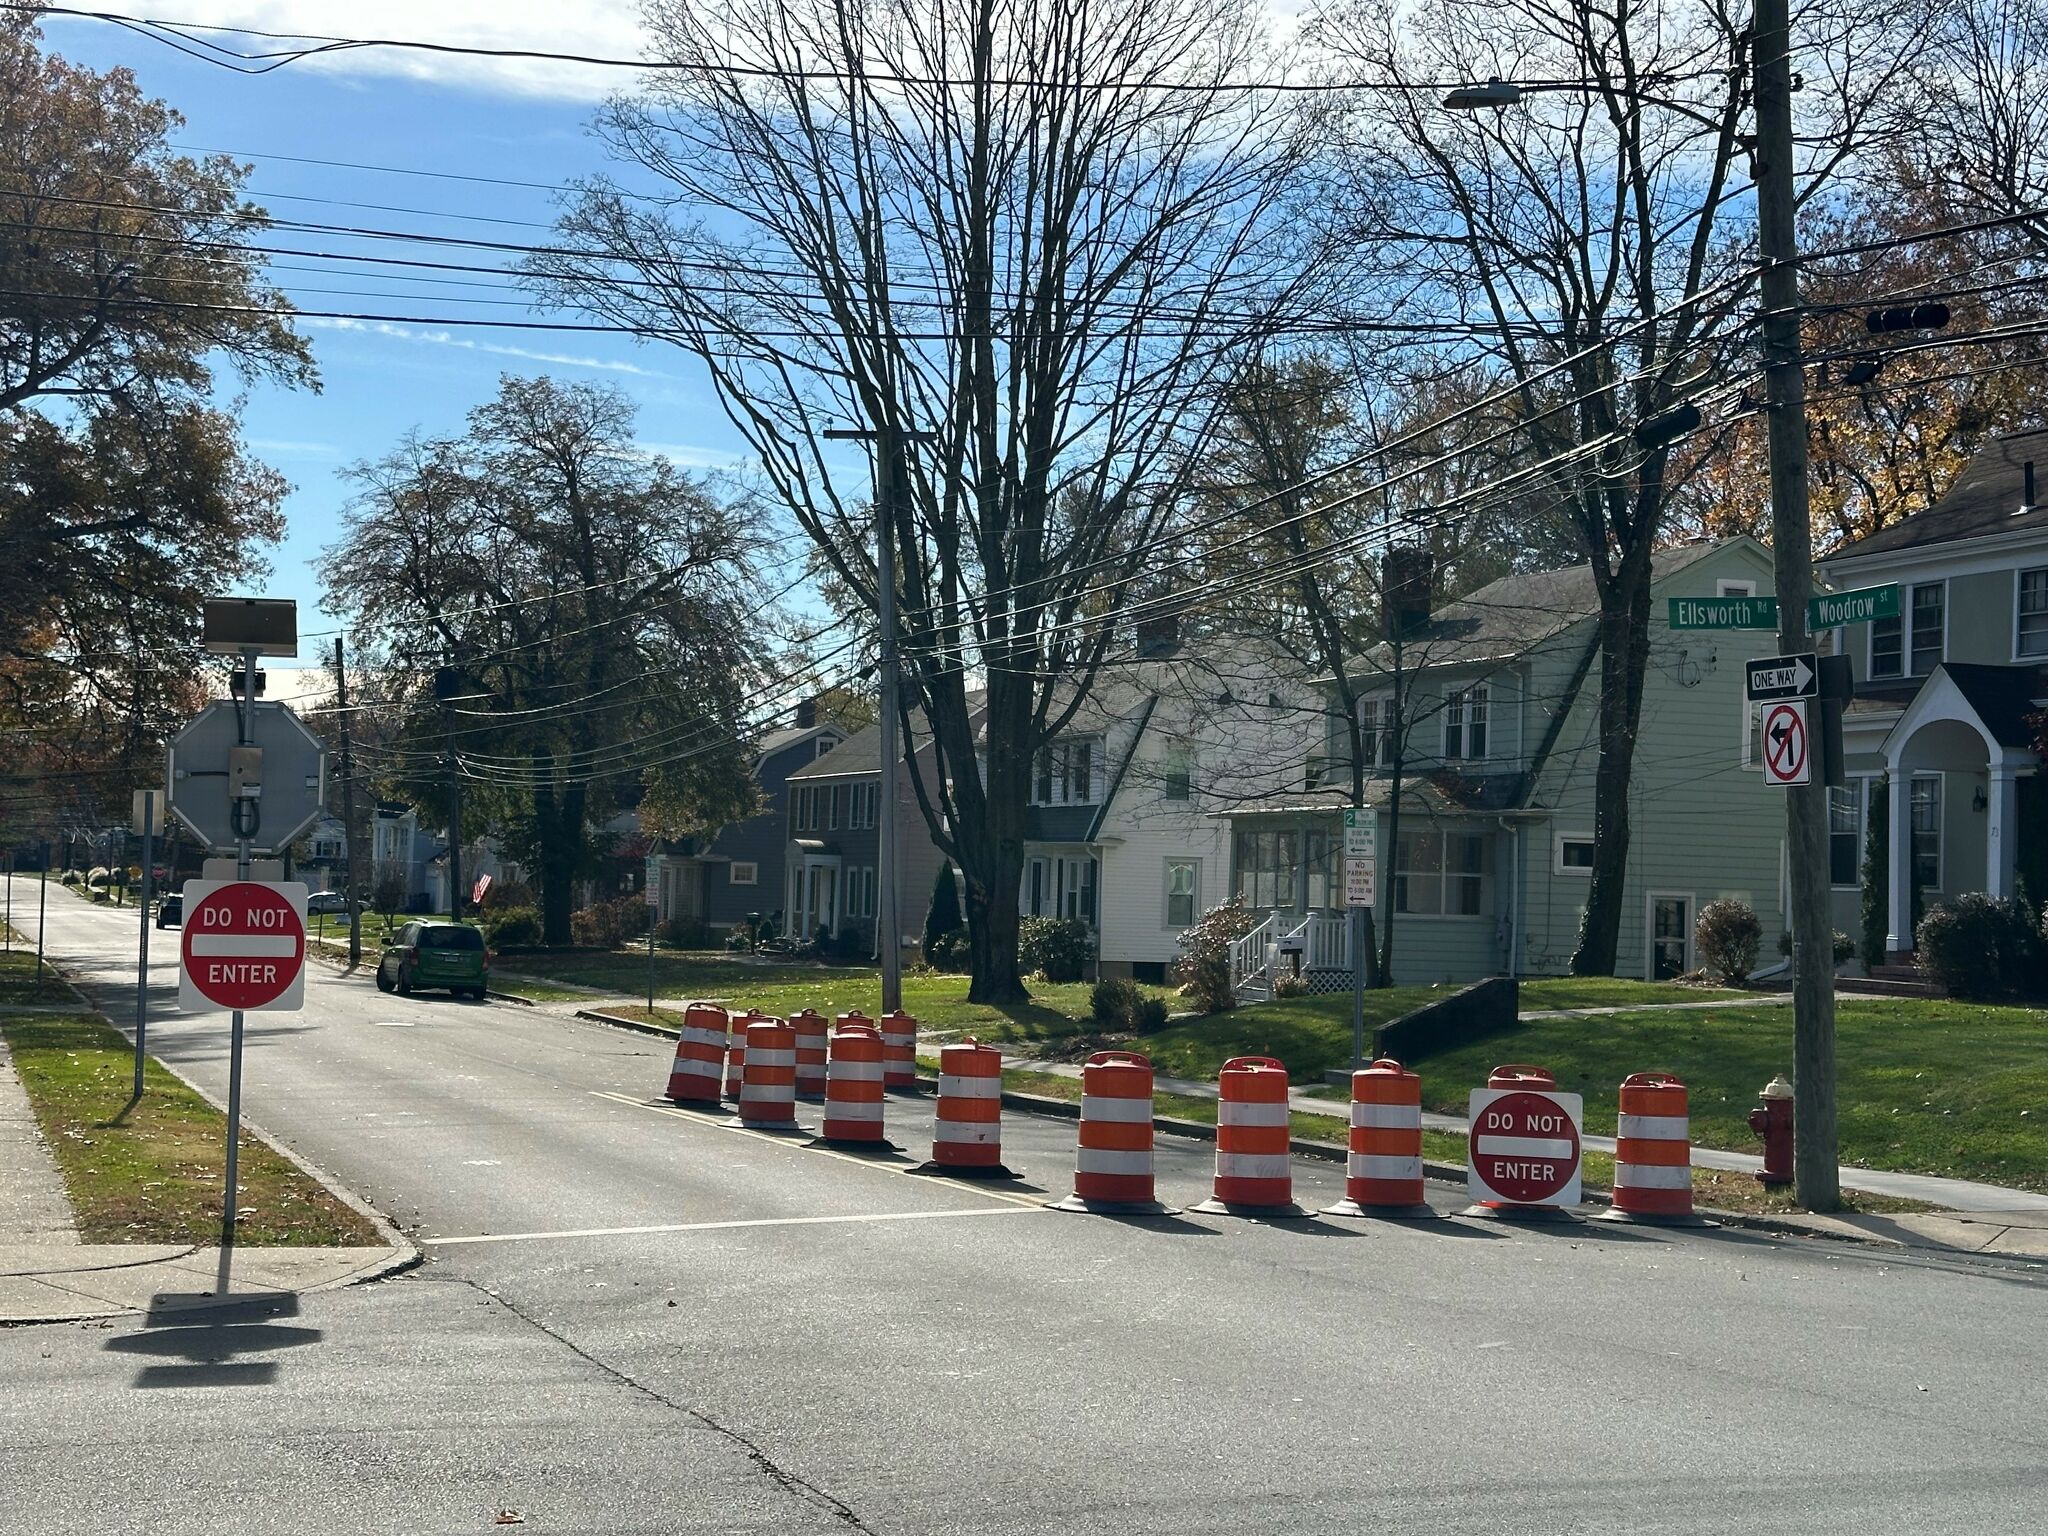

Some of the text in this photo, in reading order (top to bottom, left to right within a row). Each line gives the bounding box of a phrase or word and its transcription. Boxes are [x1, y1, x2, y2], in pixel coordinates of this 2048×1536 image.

[1678, 601, 1768, 626] Ellsworth Rd
[1818, 596, 1875, 624] Woodrow
[1754, 668, 1796, 688] ONE WAY
[1346, 813, 1354, 826] 2
[203, 907, 288, 928] DO NOT
[208, 964, 277, 984] ENTER
[1488, 1112, 1564, 1133] DO NOT
[1494, 1161, 1555, 1181] ENTER
